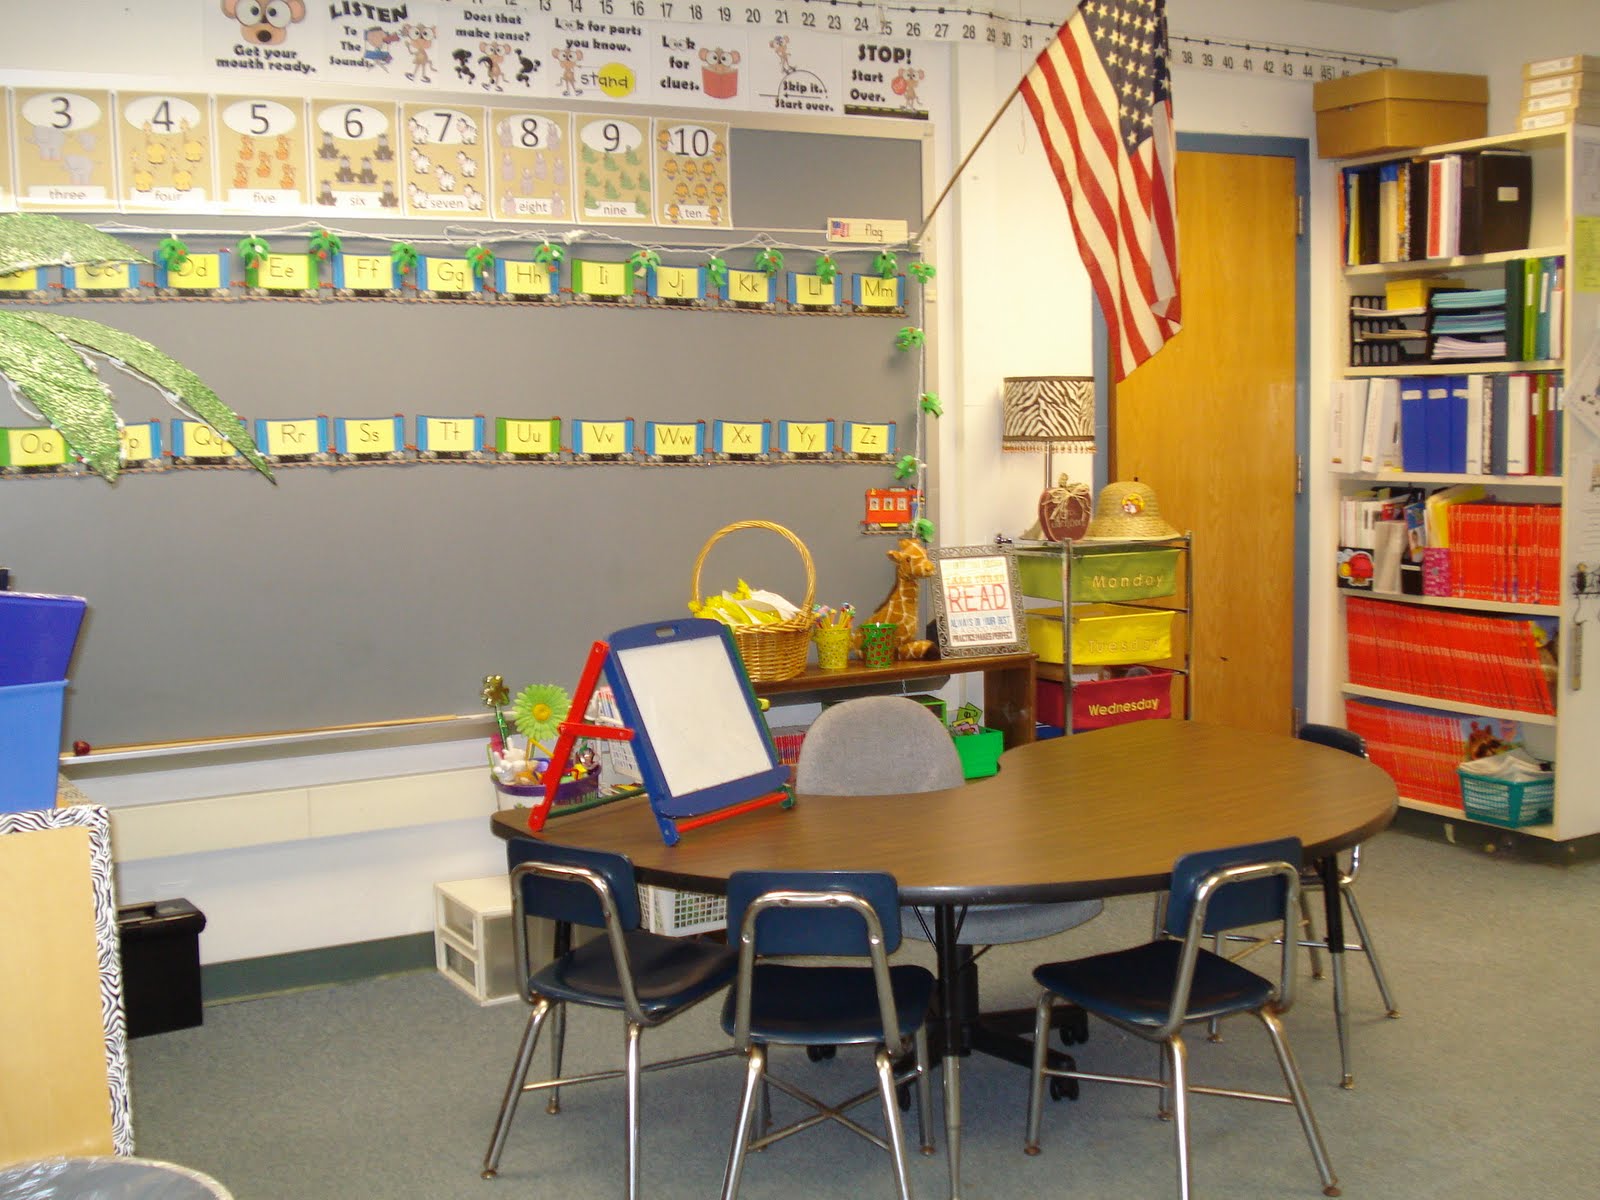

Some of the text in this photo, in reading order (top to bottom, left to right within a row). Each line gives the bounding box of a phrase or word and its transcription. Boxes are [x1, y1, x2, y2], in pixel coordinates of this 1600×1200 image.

[329, 0, 408, 23] LISTEN
[463, 10, 522, 24] Does that
[343, 25, 357, 36] To
[570, 0, 582, 13] 14
[600, 0, 614, 14] 15
[631, 0, 645, 16] 16
[660, 2, 673, 18] 17
[689, 4, 703, 20] 18
[718, 6, 732, 22] 19
[745, 8, 761, 23] 20
[775, 9, 789, 24] 21
[801, 12, 816, 27] 22
[827, 15, 841, 30] 23
[854, 17, 869, 31] 24
[906, 22, 921, 37] 26
[934, 23, 949, 38] 27
[962, 25, 976, 39] 28
[986, 27, 996, 42] 29
[1002, 31, 1012, 46] 30
[1022, 34, 1033, 48] 31
[588, 20, 606, 33] for
[609, 25, 642, 36] parts
[455, 27, 530, 41] make sense?
[233, 44, 297, 60] Get your
[340, 40, 361, 51] The
[566, 38, 631, 52] you know.
[858, 43, 912, 65] STOP!
[216, 58, 316, 75] mouth ready.
[669, 55, 690, 69] for
[1181, 50, 1193, 64] 38
[1202, 53, 1213, 66] 39
[1222, 55, 1234, 69] 40
[1243, 58, 1253, 71] 41
[1263, 60, 1274, 74] 42
[1282, 62, 1293, 76] 43
[1302, 65, 1313, 78] 44
[581, 72, 628, 89] stand
[660, 75, 700, 91] clues.
[852, 68, 883, 83] Start
[783, 80, 823, 94] Skip it.
[850, 88, 886, 103] Over.
[51, 97, 72, 129] 3
[775, 98, 834, 112] Start over.
[152, 100, 174, 132] 4
[251, 104, 269, 135] 5
[344, 108, 363, 138] 6
[433, 112, 452, 142] 7
[521, 118, 539, 147] 8
[602, 123, 621, 152] 9
[674, 127, 709, 157] 10
[49, 188, 87, 200] three
[155, 190, 182, 201] four
[253, 191, 276, 203] five
[350, 198, 365, 206] six
[430, 198, 464, 210] seven
[518, 202, 548, 214] eight
[603, 204, 627, 216] nine
[685, 208, 703, 219] ten
[864, 225, 883, 242] flag
[269, 257, 295, 278] Ee
[356, 258, 380, 278] Ff
[437, 262, 465, 290] Gg
[516, 264, 542, 285] Hh
[599, 265, 609, 285] Ii
[668, 270, 685, 297] Jj
[739, 273, 759, 294] Kk
[864, 279, 893, 298] Mm
[281, 423, 307, 443] Rr
[359, 422, 380, 442] Ss
[439, 421, 461, 441] Tt
[517, 423, 541, 443] Uu
[592, 425, 614, 443] Vv
[657, 427, 692, 445] Ww
[731, 426, 752, 445] Xx
[796, 425, 816, 451] Yy
[859, 426, 877, 445] Zz
[20, 432, 53, 454] Oo
[1092, 573, 1164, 589] Monday
[946, 583, 1008, 613] READ
[1088, 639, 1160, 654] Tuesday
[1088, 698, 1159, 717] Wednesday
